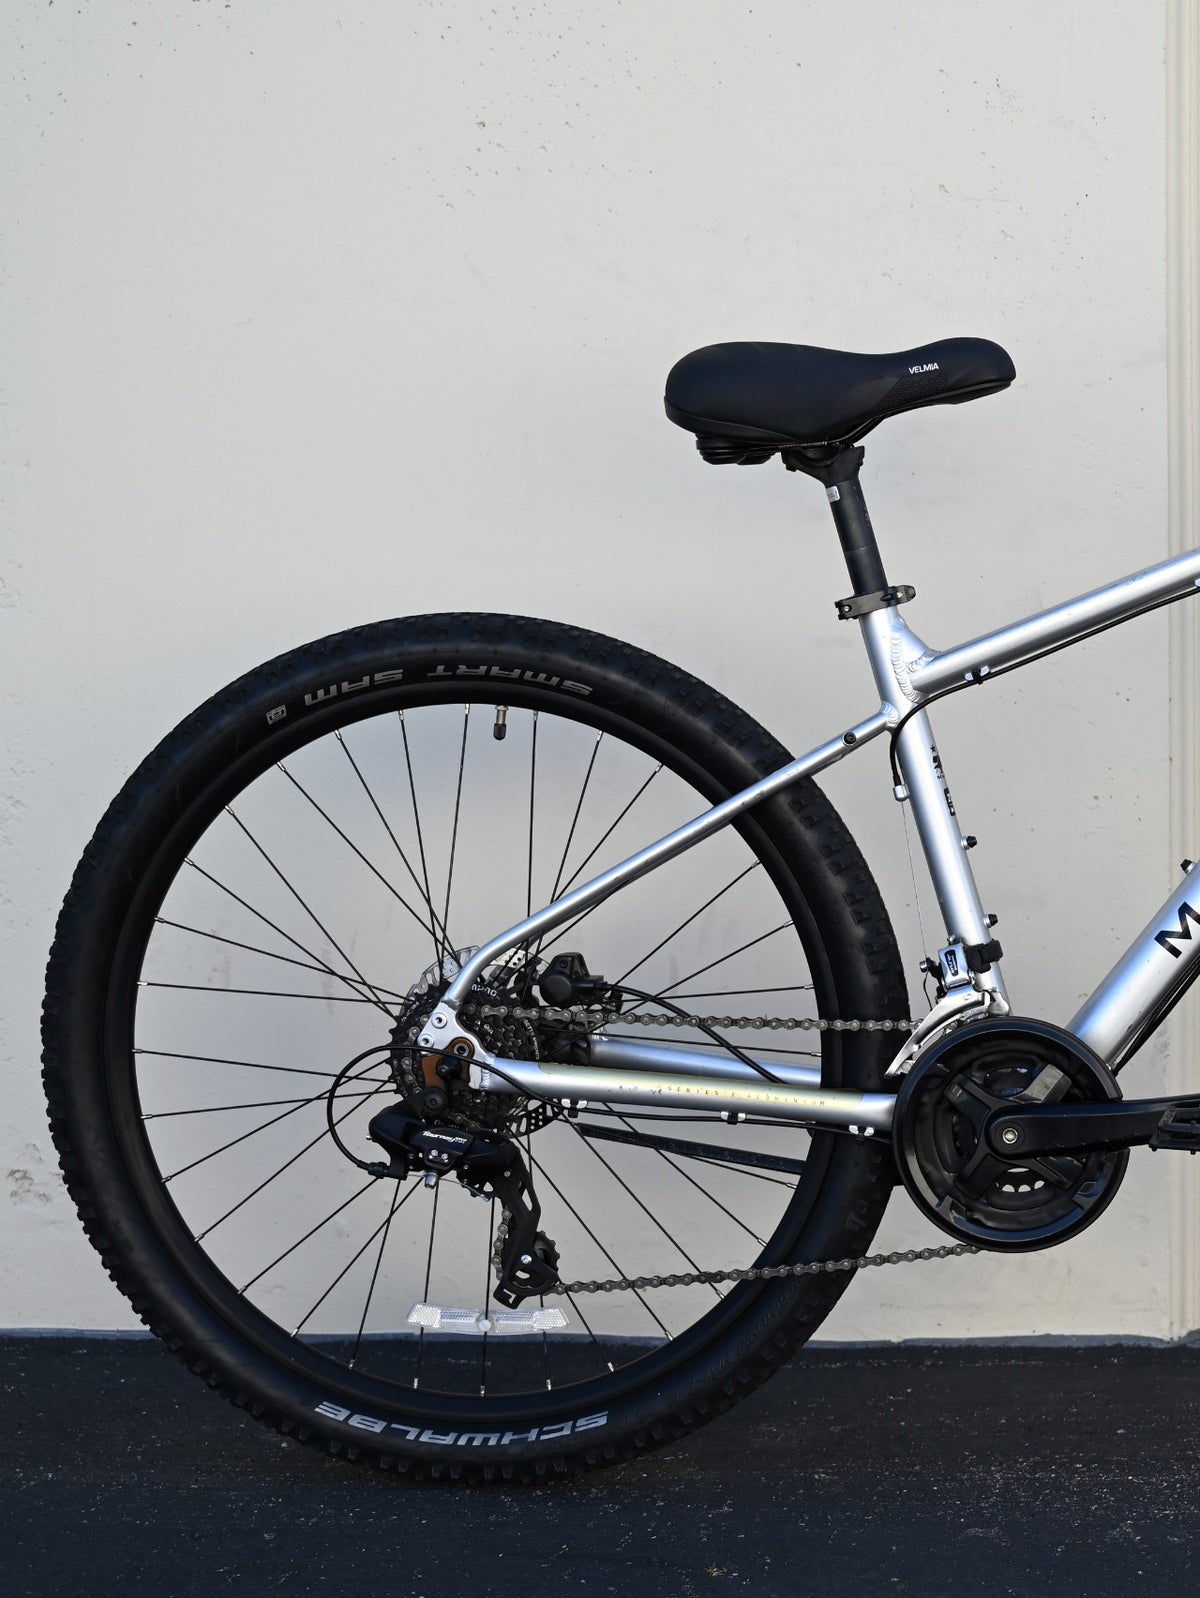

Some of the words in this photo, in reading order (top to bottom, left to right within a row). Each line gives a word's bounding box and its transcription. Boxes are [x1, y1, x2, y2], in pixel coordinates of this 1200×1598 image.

[908, 362, 939, 375] VELMIA
[304, 669, 404, 707] SAM
[427, 664, 594, 696] SMART
[313, 1401, 609, 1446] SCHWALBE
